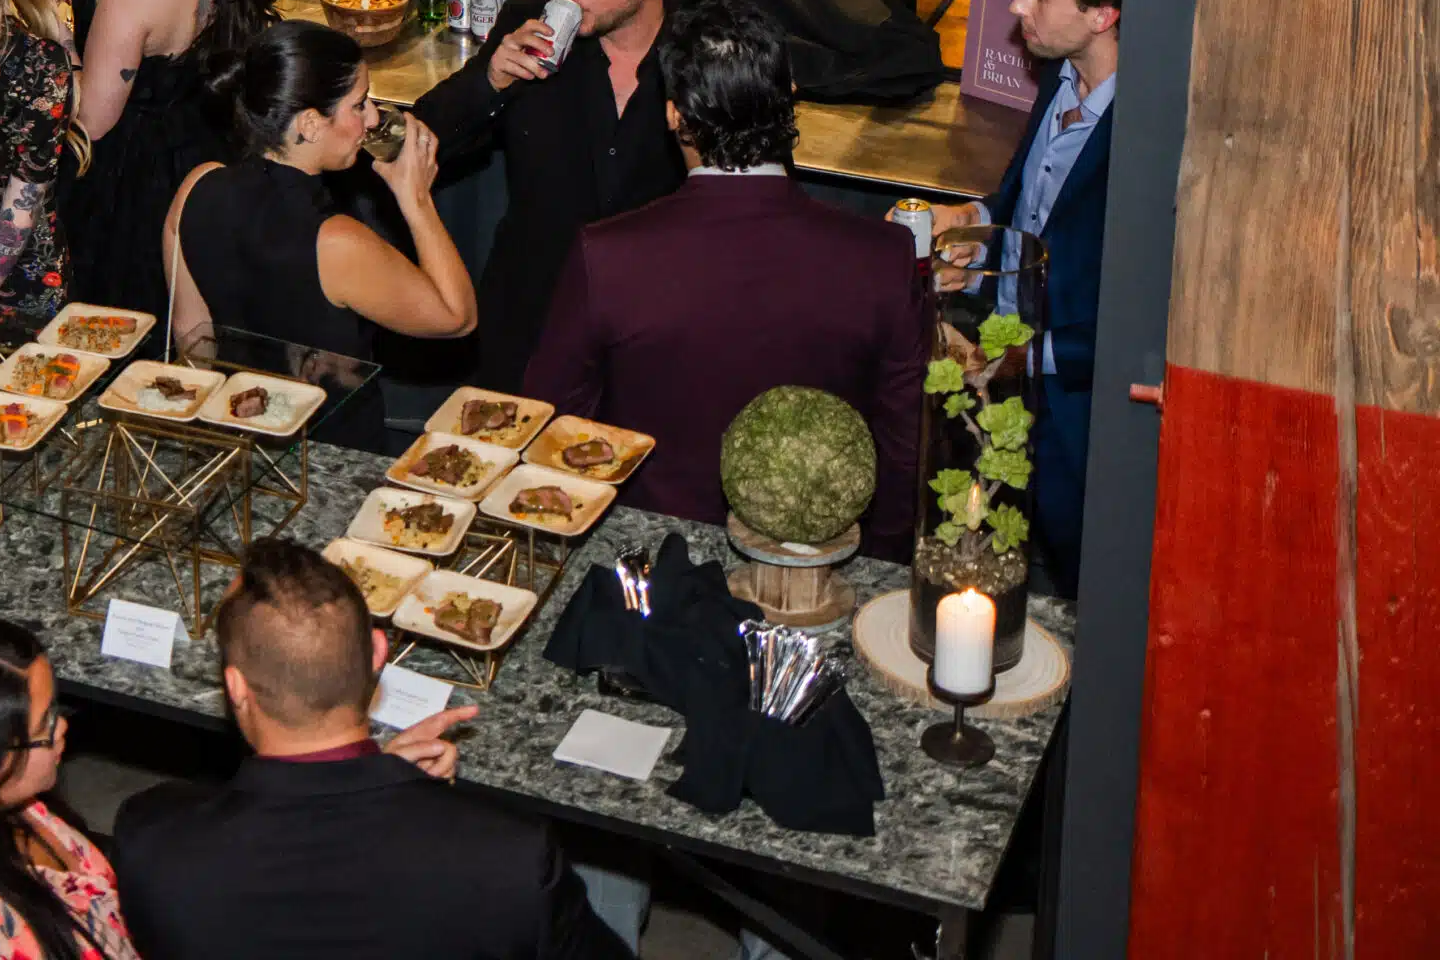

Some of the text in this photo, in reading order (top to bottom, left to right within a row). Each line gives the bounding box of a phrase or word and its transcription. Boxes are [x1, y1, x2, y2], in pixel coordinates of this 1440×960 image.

[471, 14, 494, 24] AGER
[983, 60, 995, 70] &
[983, 69, 1023, 89] BRIAN
